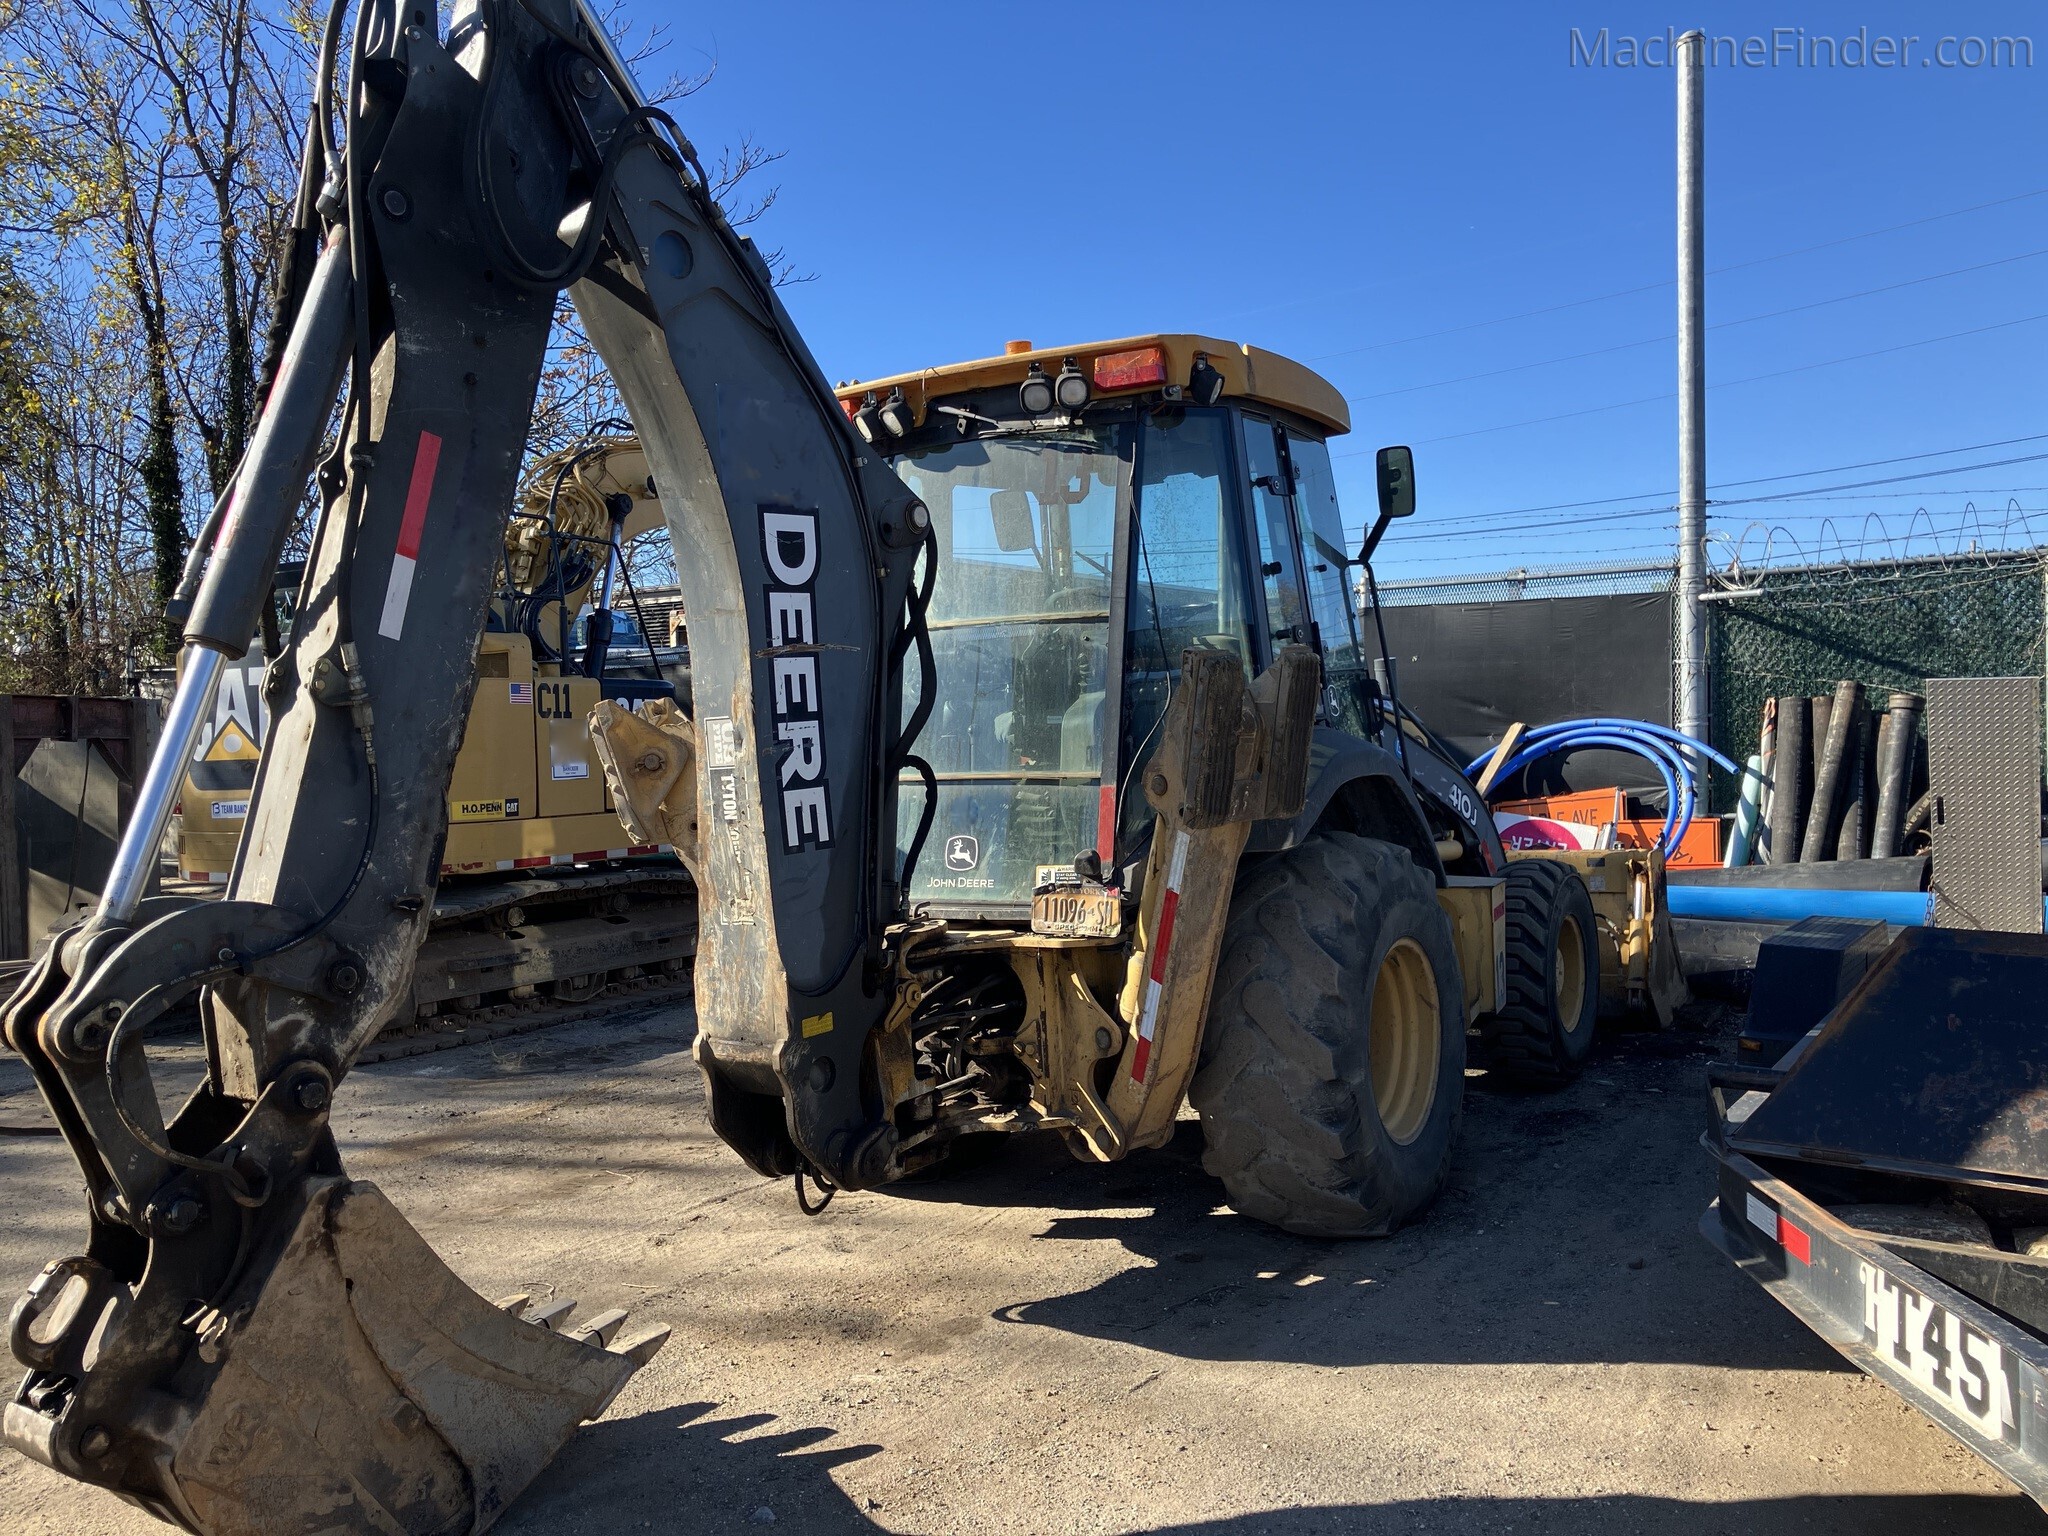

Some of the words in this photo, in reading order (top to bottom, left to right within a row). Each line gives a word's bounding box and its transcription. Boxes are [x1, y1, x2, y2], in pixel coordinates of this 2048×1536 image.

[762, 511, 831, 848] DEERE
[193, 667, 271, 762] AT
[537, 683, 572, 719] C11
[221, 804, 234, 814] TEAM
[506, 802, 518, 813] CAT
[720, 774, 738, 820] TYTON
[1448, 783, 1478, 827] 410J
[1572, 808, 1598, 828] AVE
[927, 876, 956, 888] JOHN
[957, 876, 995, 888] DEERE
[1079, 887, 1101, 896] YORK
